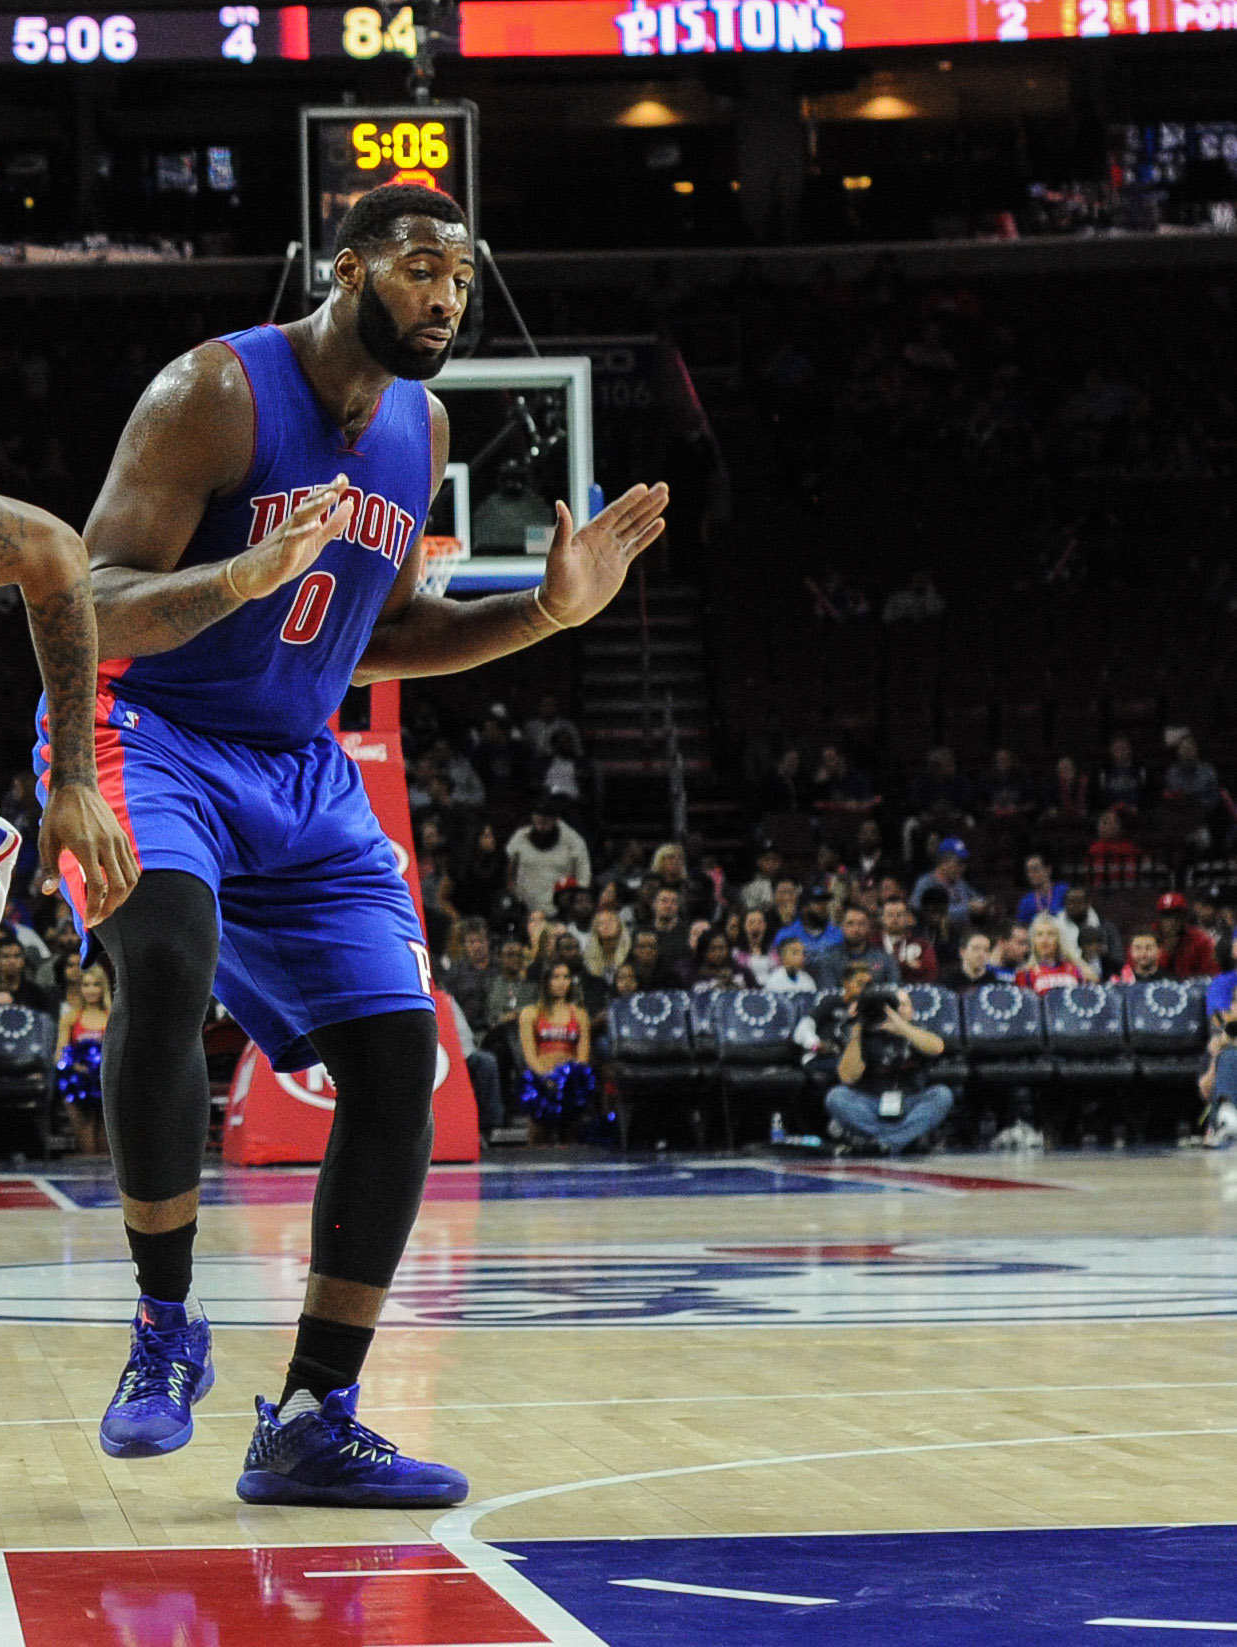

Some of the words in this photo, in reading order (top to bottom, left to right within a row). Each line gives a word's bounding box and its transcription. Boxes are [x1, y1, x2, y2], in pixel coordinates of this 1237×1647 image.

[12, 15, 137, 64] 5:06
[222, 23, 257, 64] 4
[342, 6, 417, 59] 84
[615, 0, 845, 56] PISTONS
[997, 1, 1028, 42] 2
[352, 122, 449, 169] 5:06
[280, 571, 336, 645] 0
